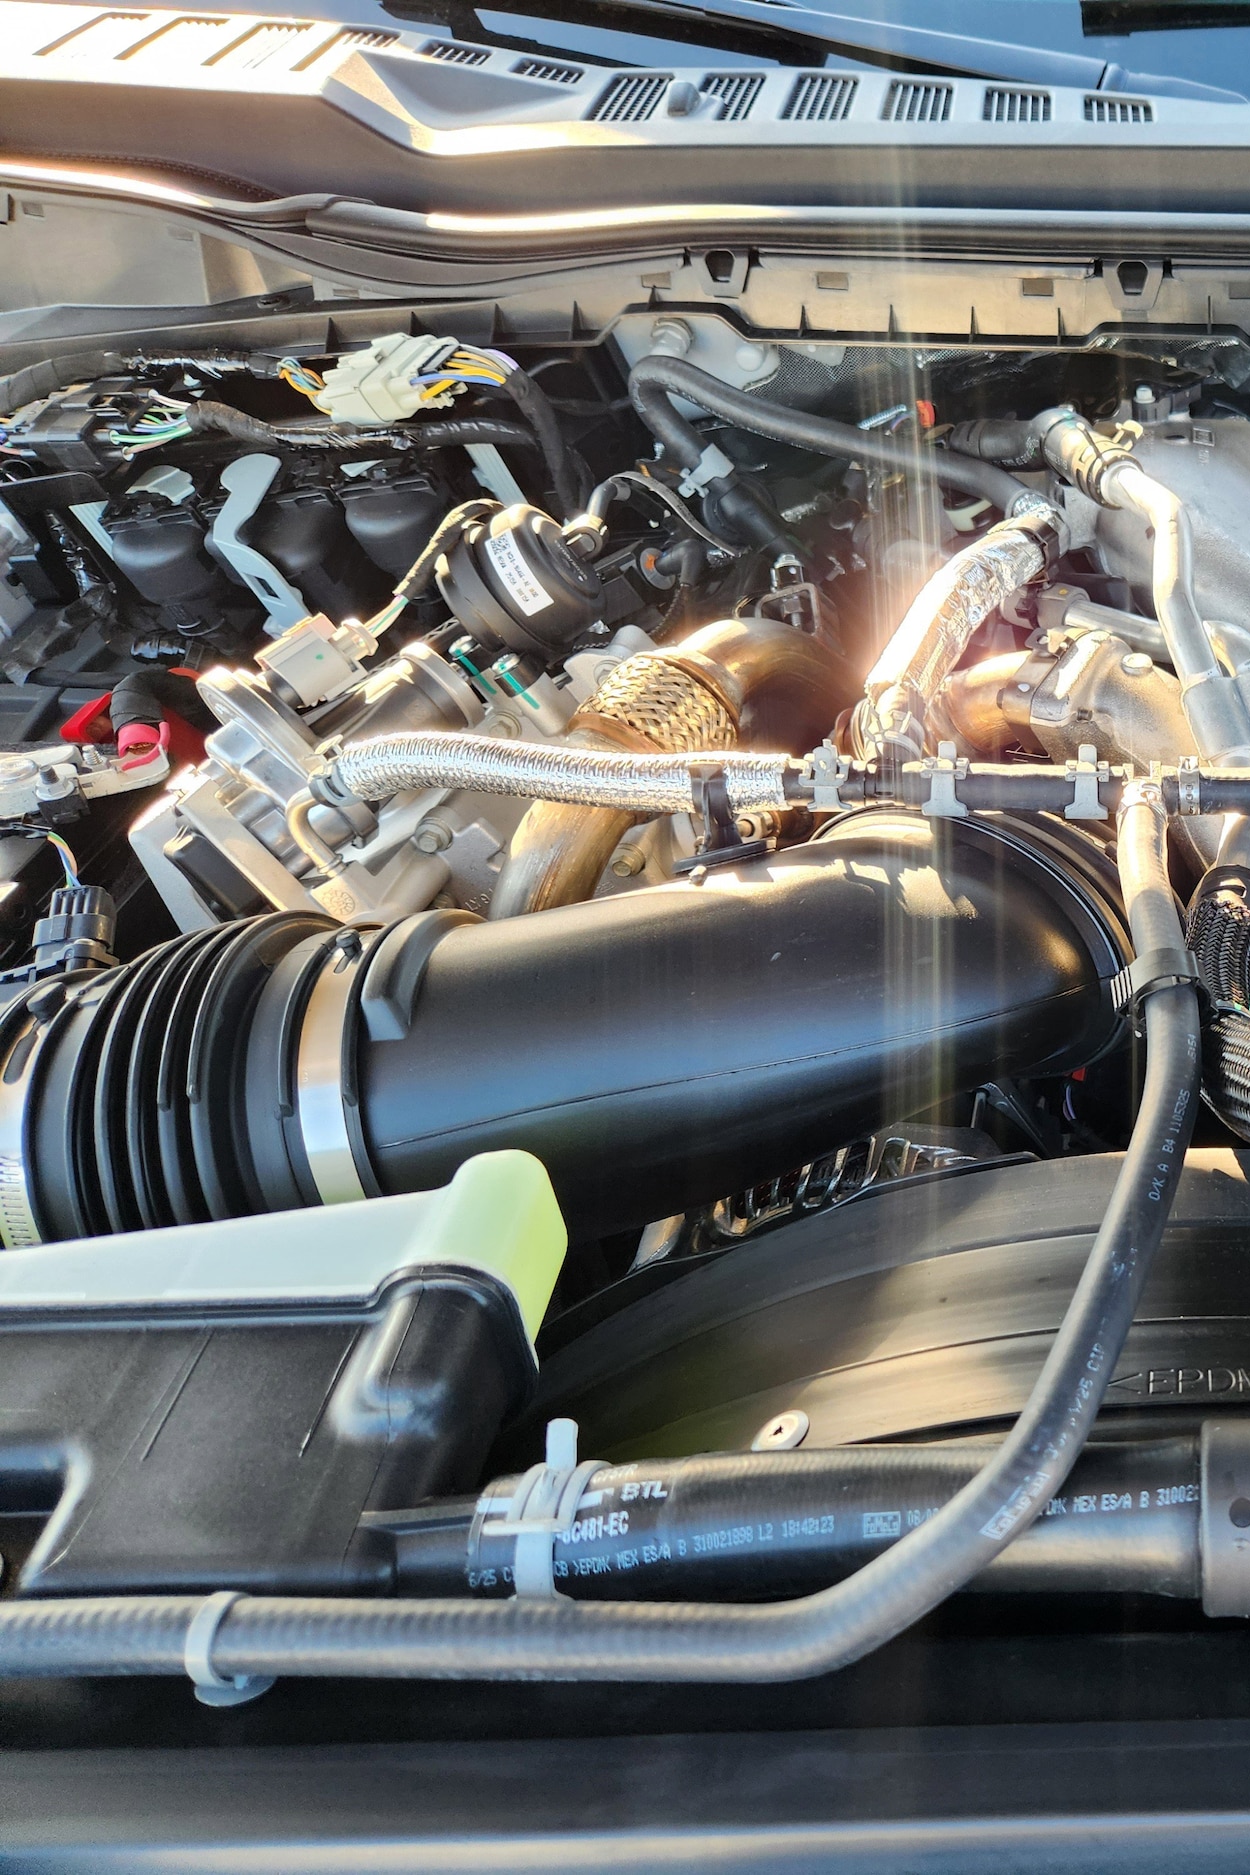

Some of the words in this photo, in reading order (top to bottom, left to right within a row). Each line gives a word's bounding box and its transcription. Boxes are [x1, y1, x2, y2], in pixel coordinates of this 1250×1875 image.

[620, 1480, 668, 1501] BTL
[1139, 1490, 1150, 1509] B
[616, 1550, 639, 1571] MEX
[677, 1539, 687, 1556] B
[758, 1523, 774, 1541] L2
